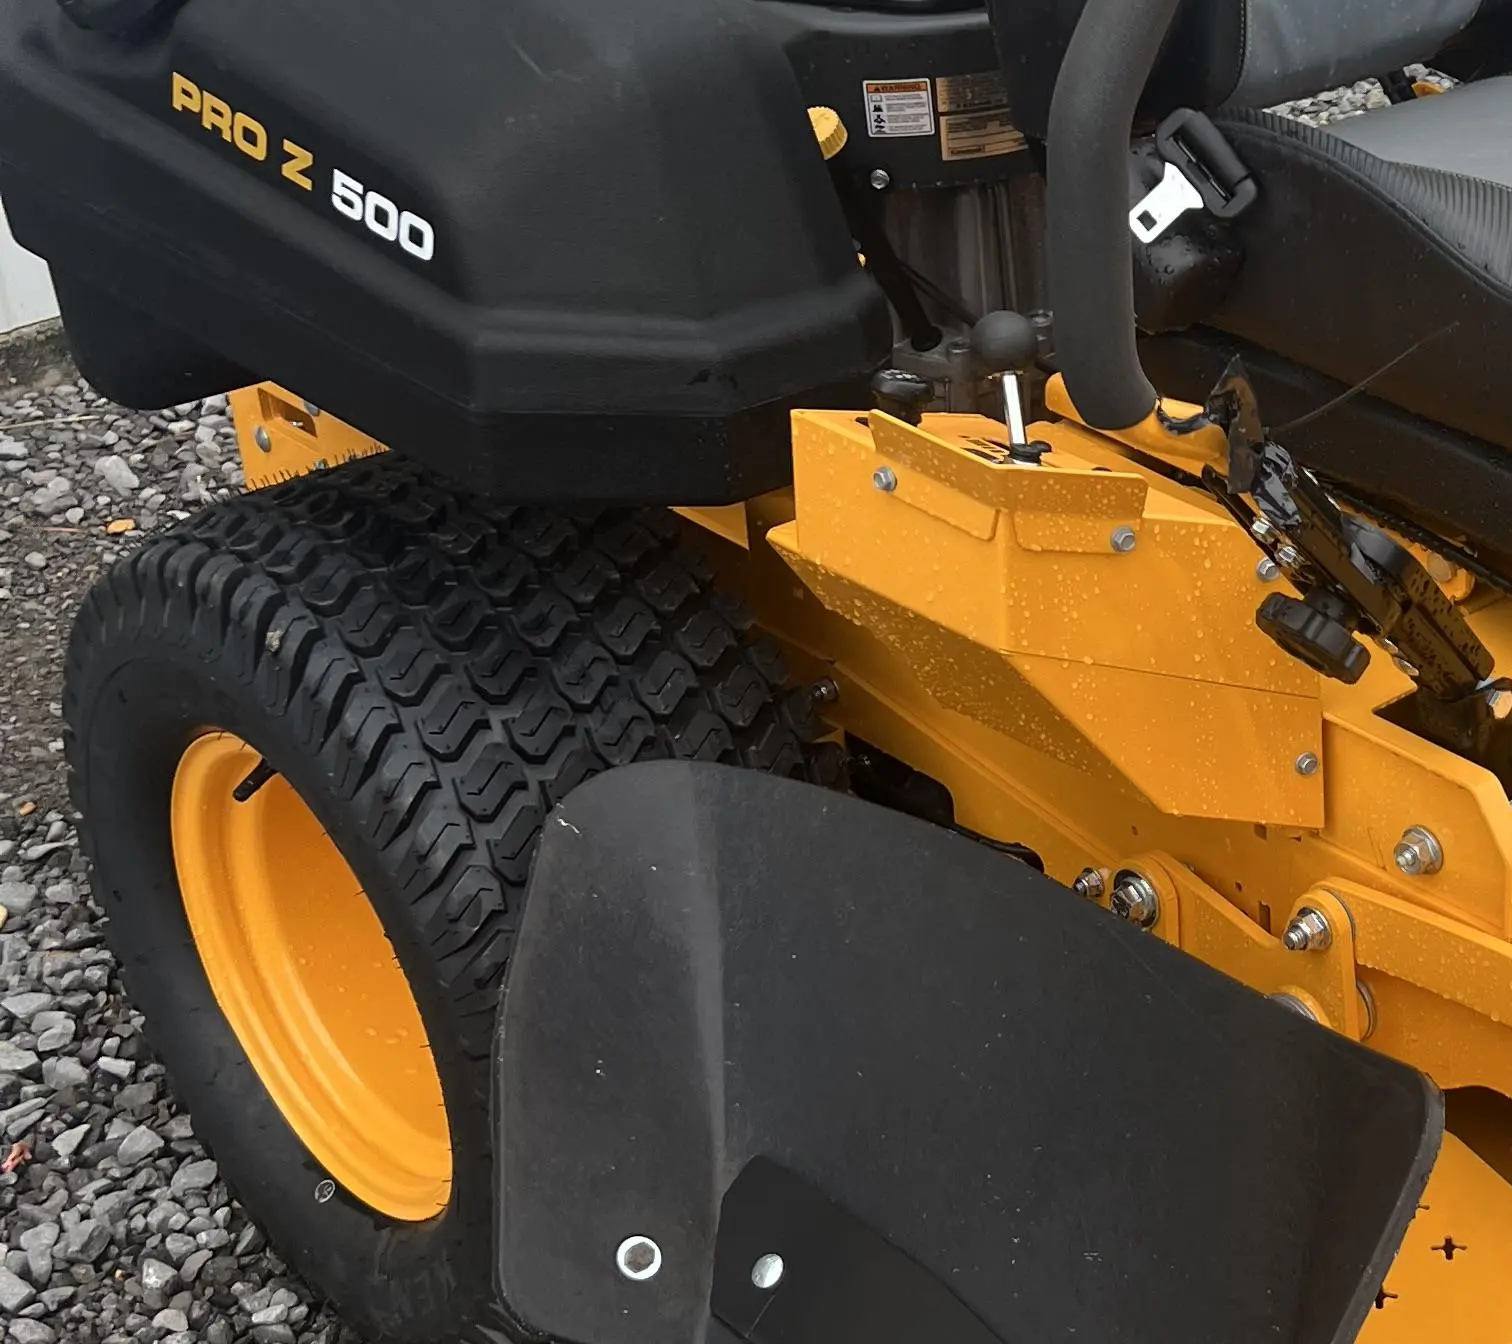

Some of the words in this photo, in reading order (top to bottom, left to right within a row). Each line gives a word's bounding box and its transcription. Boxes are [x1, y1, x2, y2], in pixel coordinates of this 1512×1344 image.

[172, 71, 268, 161] PRO
[281, 138, 314, 191] Z
[331, 168, 434, 261] 500
